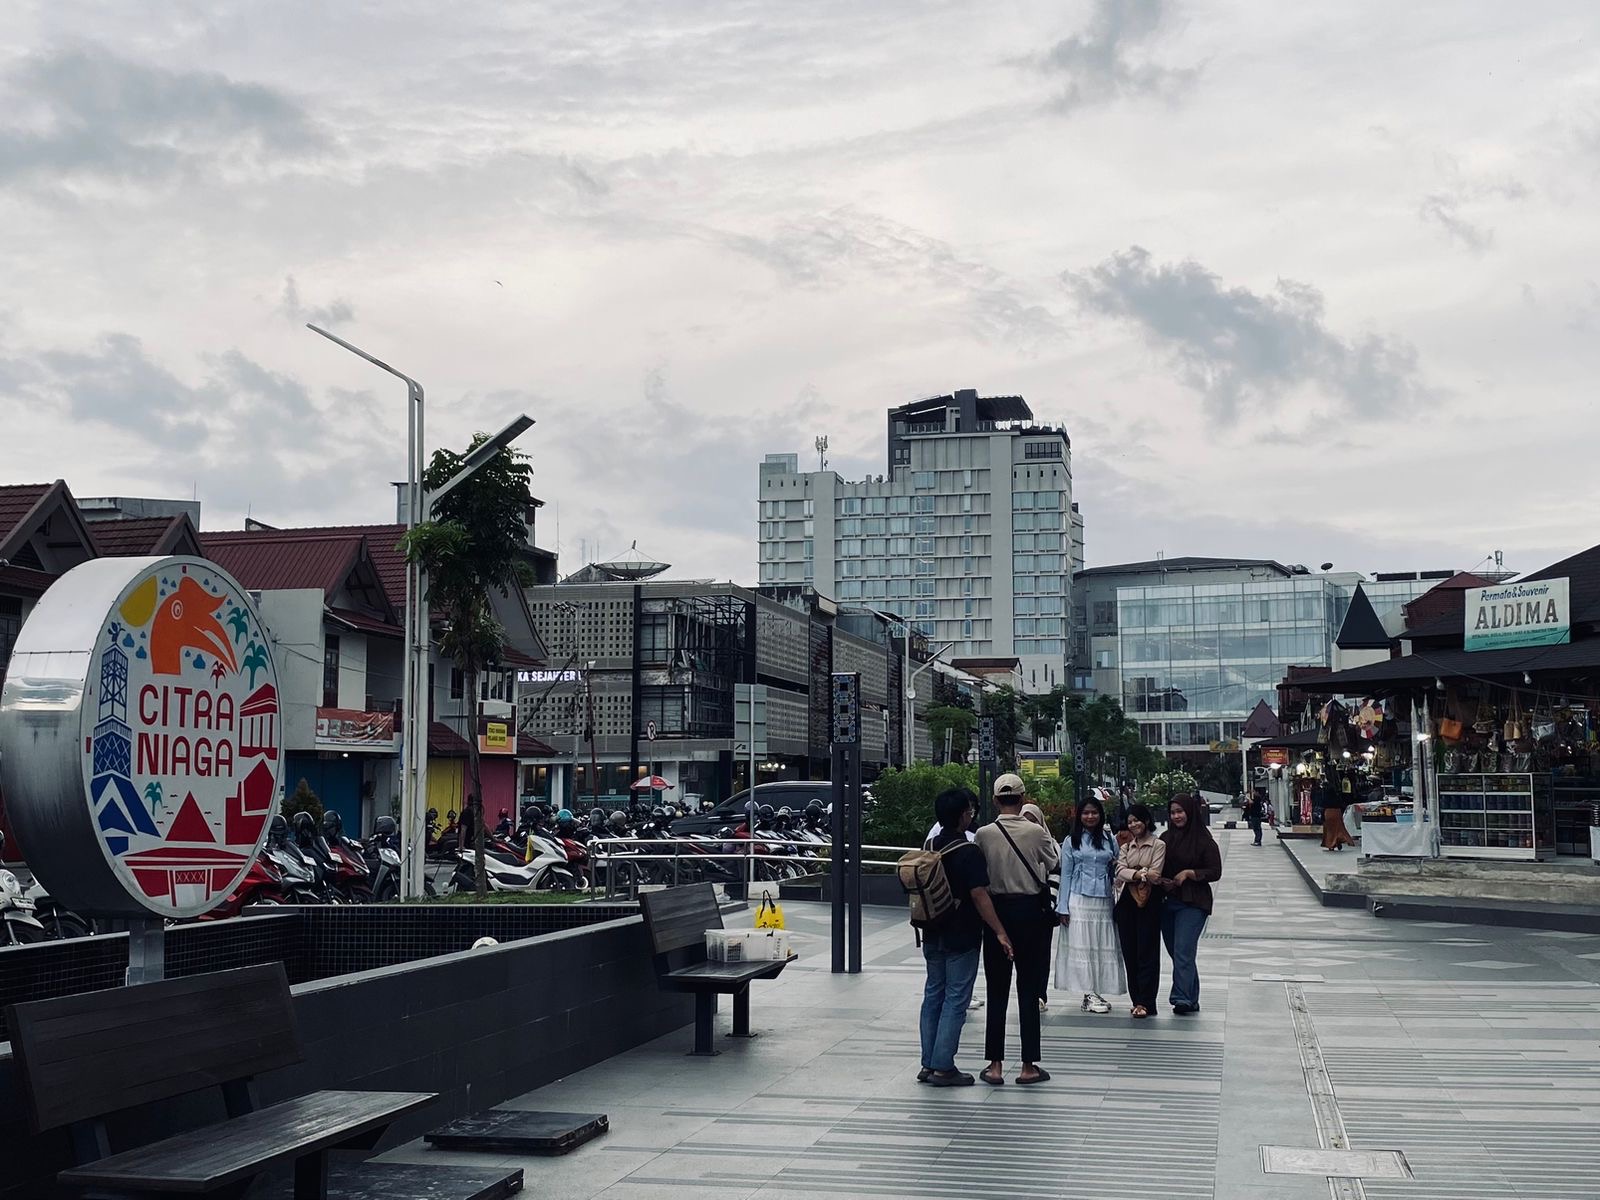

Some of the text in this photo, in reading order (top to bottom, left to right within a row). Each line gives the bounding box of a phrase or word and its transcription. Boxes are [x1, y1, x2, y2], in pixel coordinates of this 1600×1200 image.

[1474, 598, 1559, 630] ALDIMA
[139, 684, 234, 731] CITRA
[137, 732, 233, 777] NIAGA
